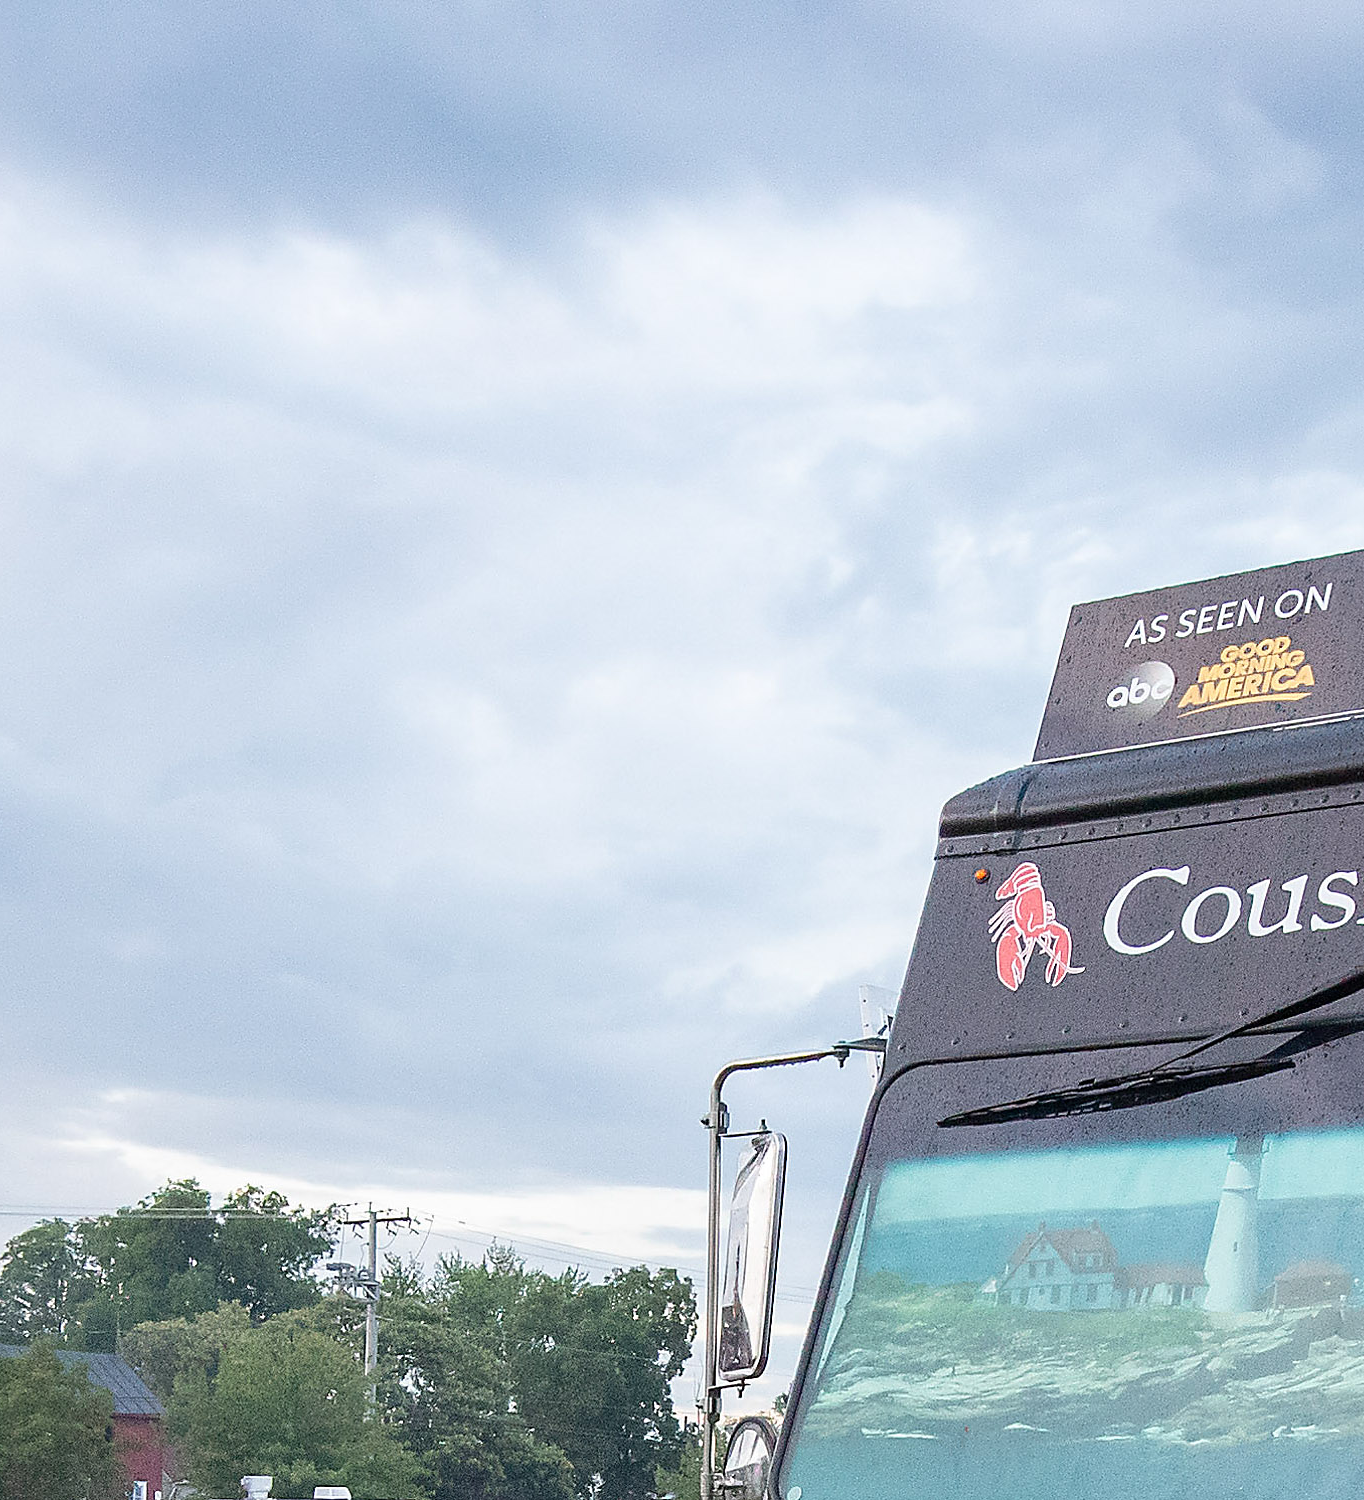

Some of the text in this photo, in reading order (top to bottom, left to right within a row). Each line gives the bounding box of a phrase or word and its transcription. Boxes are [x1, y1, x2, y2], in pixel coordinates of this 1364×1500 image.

[1123, 582, 1333, 648] AS SEEN ON
[1196, 649, 1306, 684] MORNING
[1220, 635, 1292, 663] GOOD
[1106, 676, 1173, 708] abc
[1177, 664, 1315, 709] AMERICA
